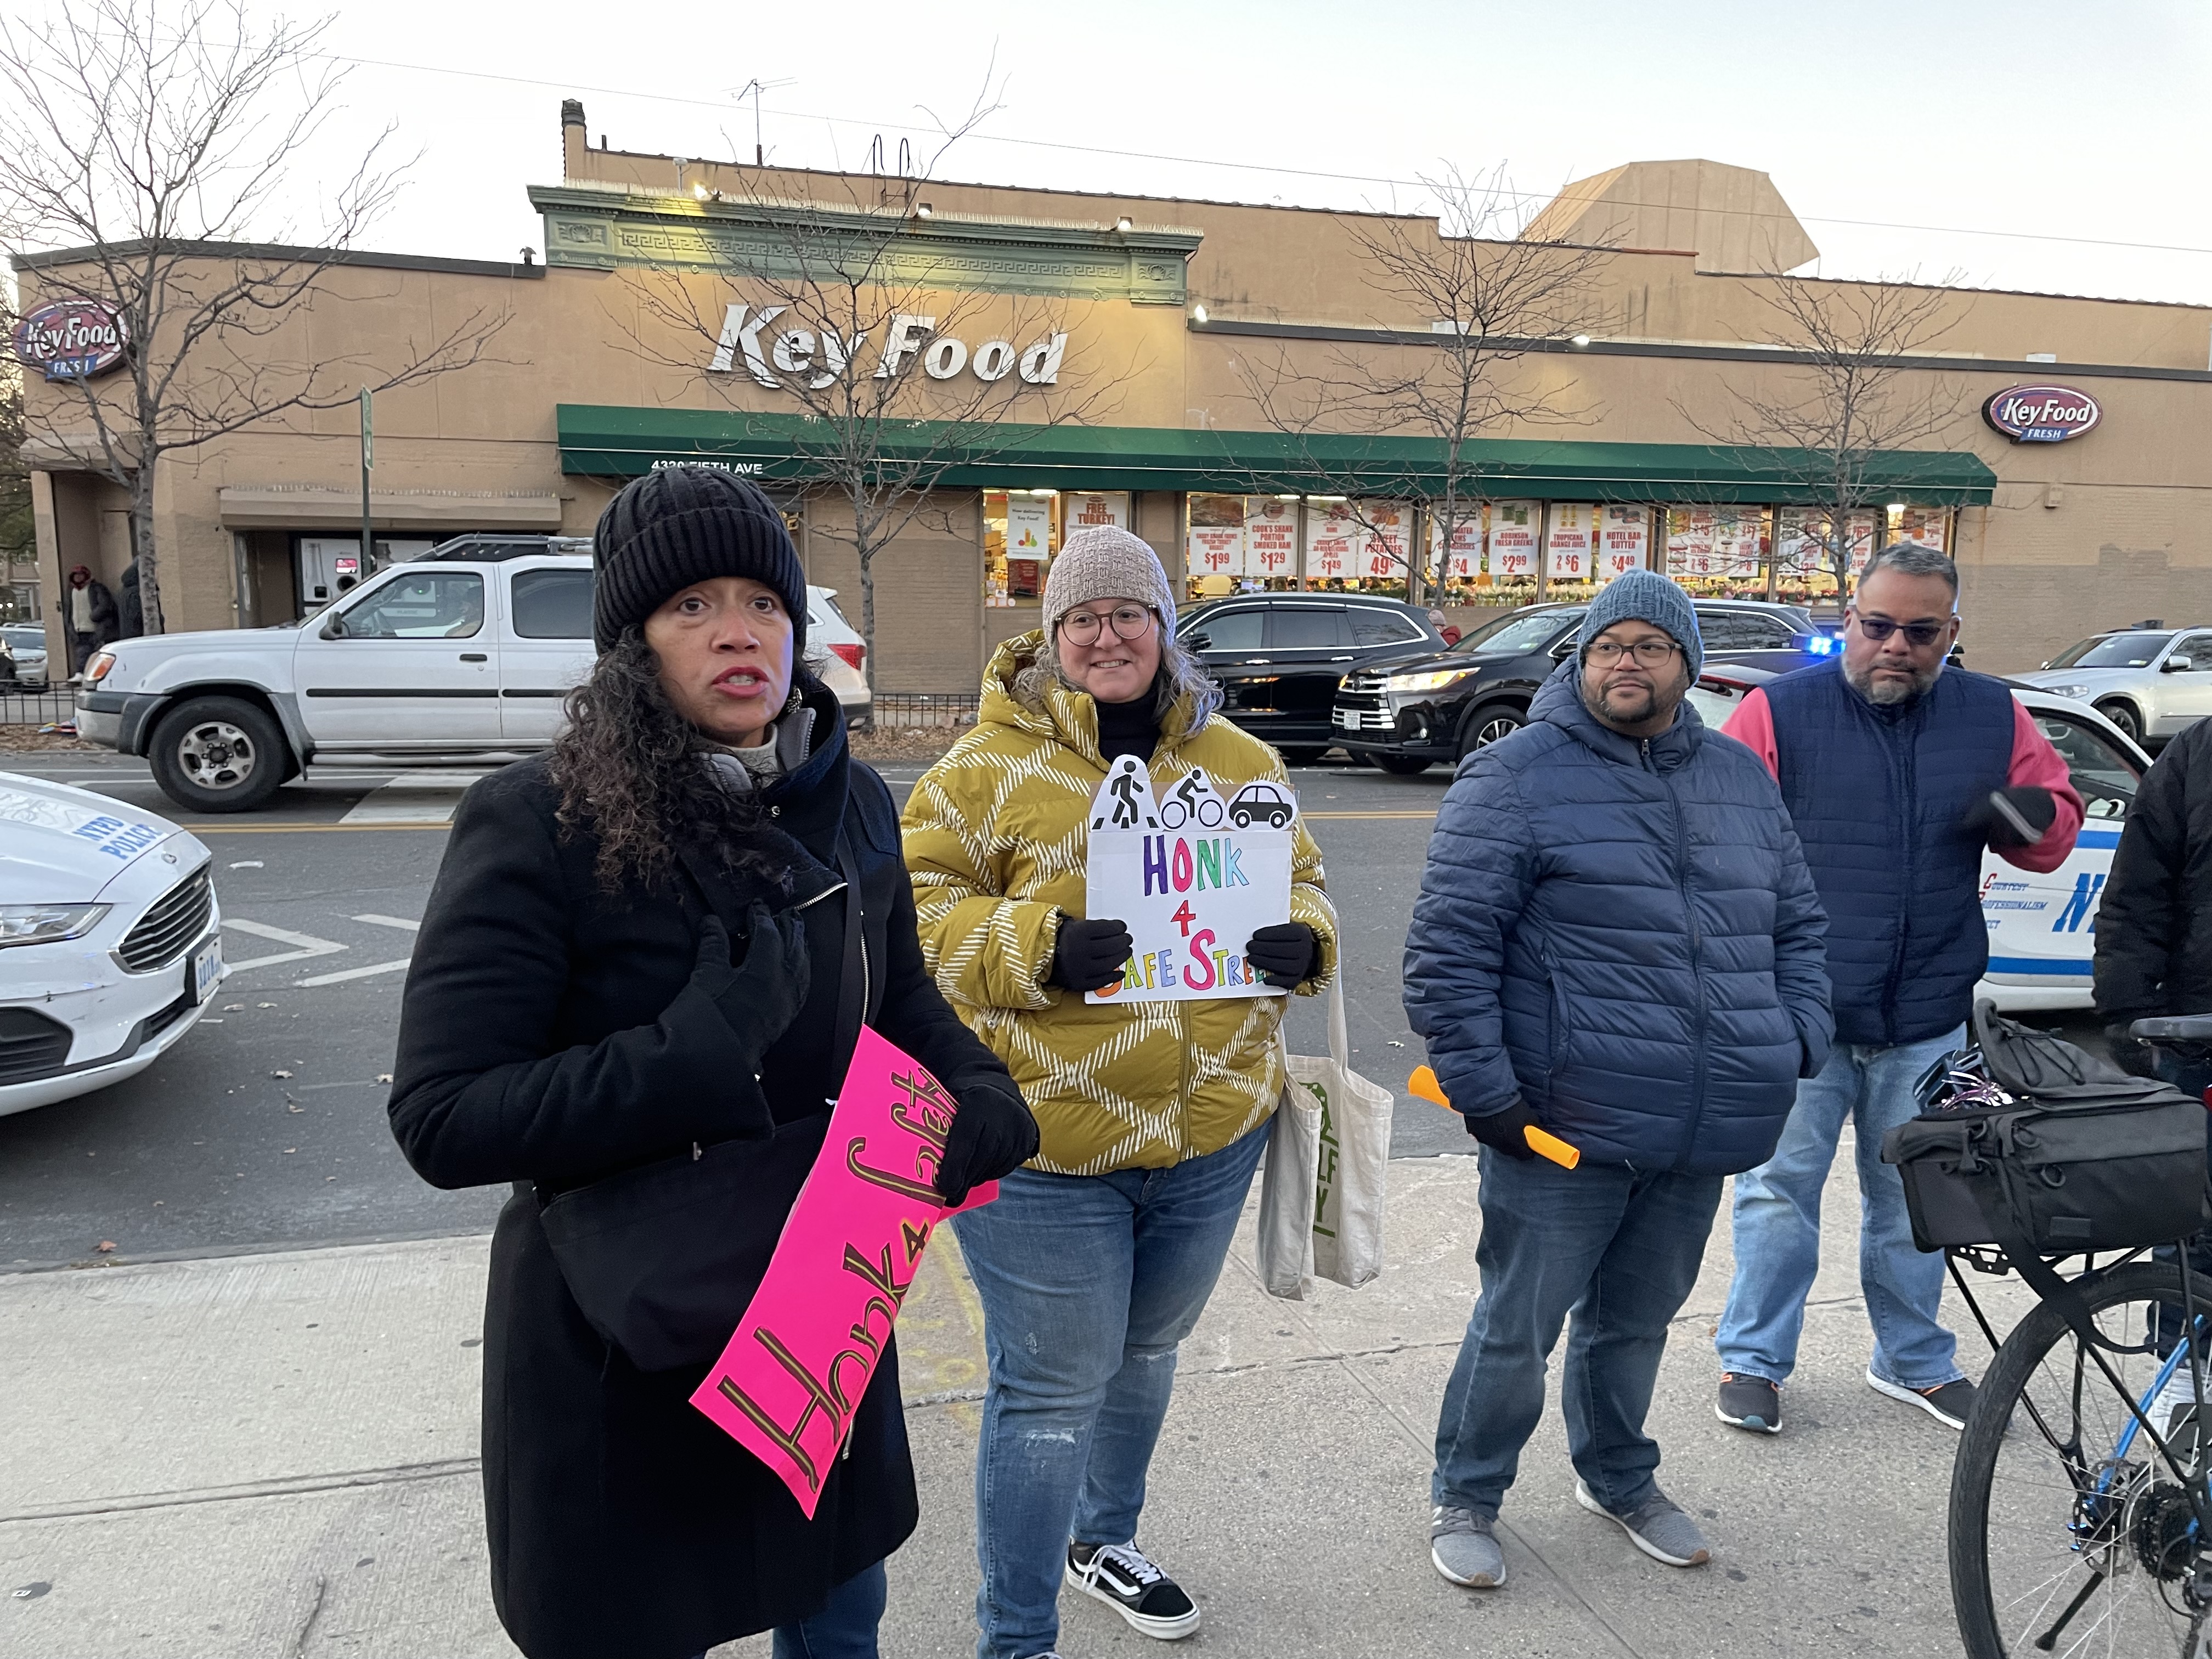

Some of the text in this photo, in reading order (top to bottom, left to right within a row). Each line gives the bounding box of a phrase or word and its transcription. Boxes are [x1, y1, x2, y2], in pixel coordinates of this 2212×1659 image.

[706, 303, 1068, 389] Key Food
[2027, 429, 2061, 438] FRESH
[734, 463, 763, 475] AVE
[1077, 514, 1115, 524] TURKEY!
[1086, 503, 1107, 514] FREE
[1611, 541, 1636, 549] BUTTER
[1565, 555, 1579, 572] $6
[72, 816, 125, 841] NYPD
[99, 823, 163, 860] POLICE
[1143, 834, 1250, 896] HONK
[1170, 900, 1197, 937] 4
[1183, 928, 1266, 991] STREE
[716, 1242, 911, 1493] Honk
[901, 1218, 930, 1266] 4
